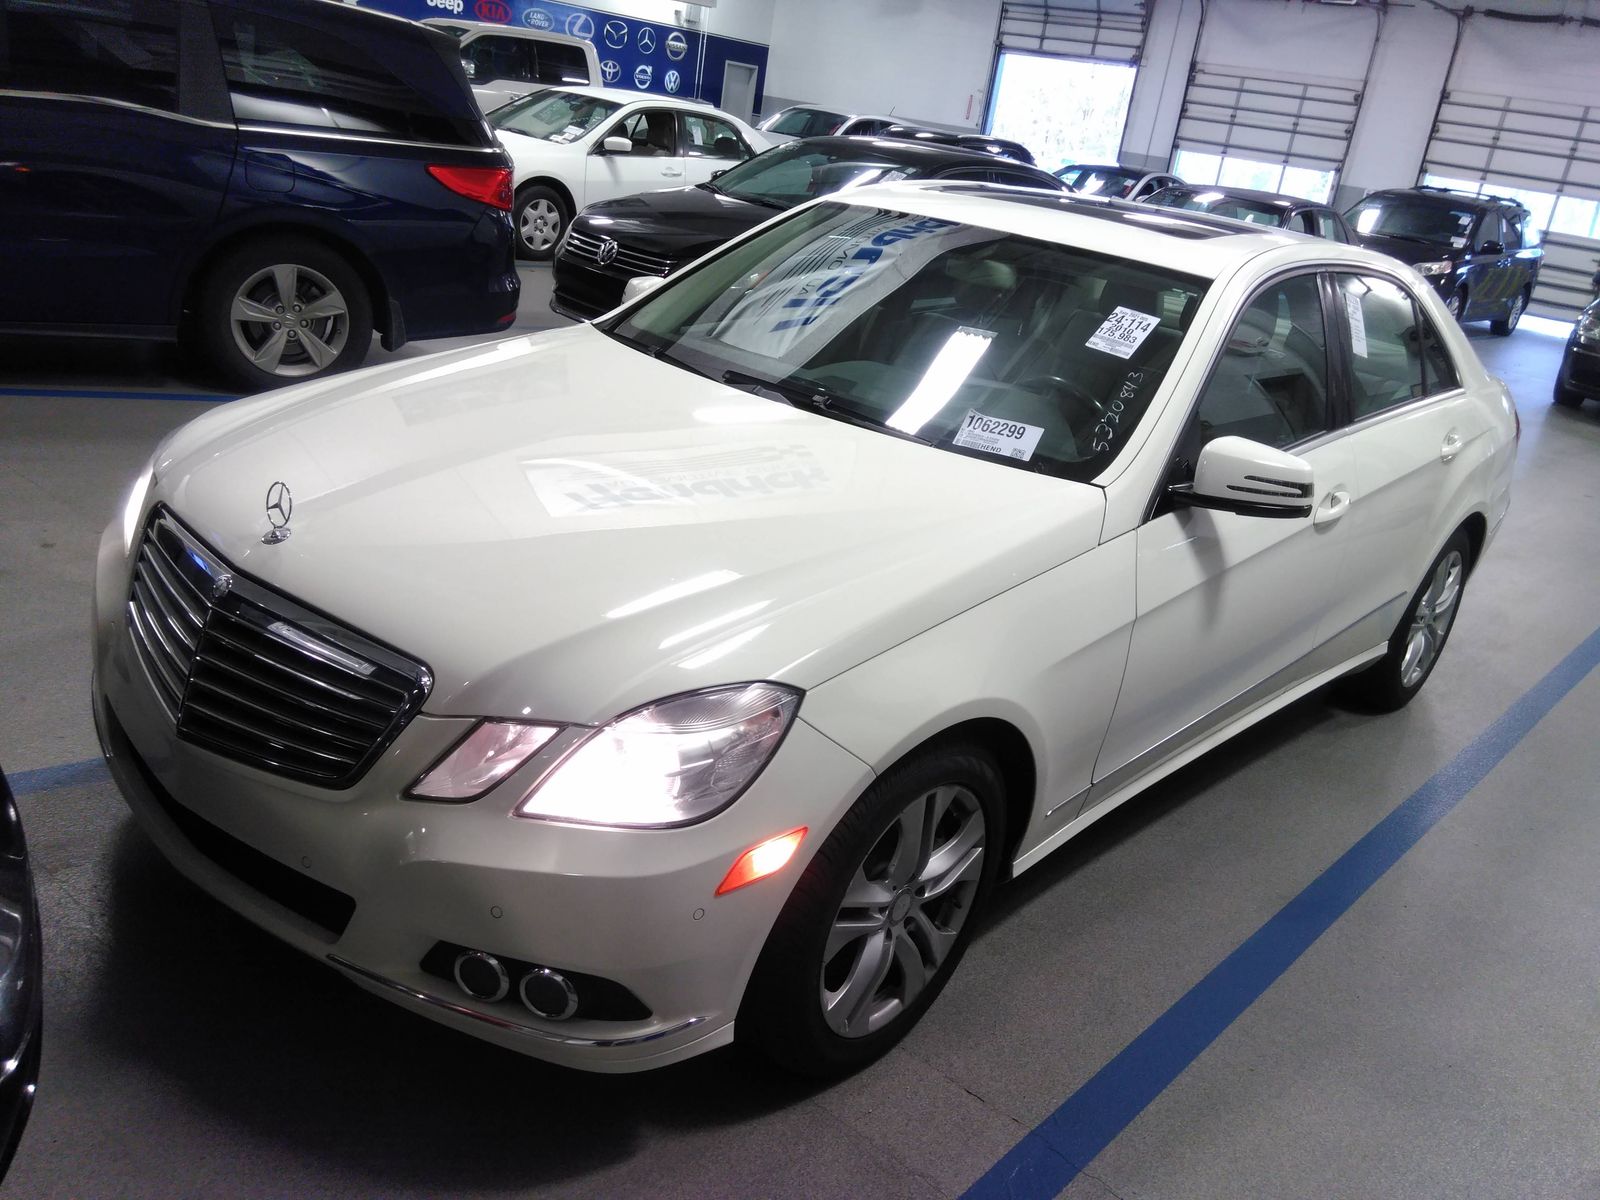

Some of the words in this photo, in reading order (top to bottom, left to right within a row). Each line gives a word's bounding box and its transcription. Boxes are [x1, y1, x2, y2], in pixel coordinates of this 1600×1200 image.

[482, 3, 506, 20] KIA
[530, 12, 546, 20] LAND
[531, 18, 549, 28] ROVER
[667, 43, 686, 51] NISSAN
[1109, 323, 1135, 335] 2010
[967, 415, 1026, 439] 1062299
[980, 444, 1002, 452] HEND
